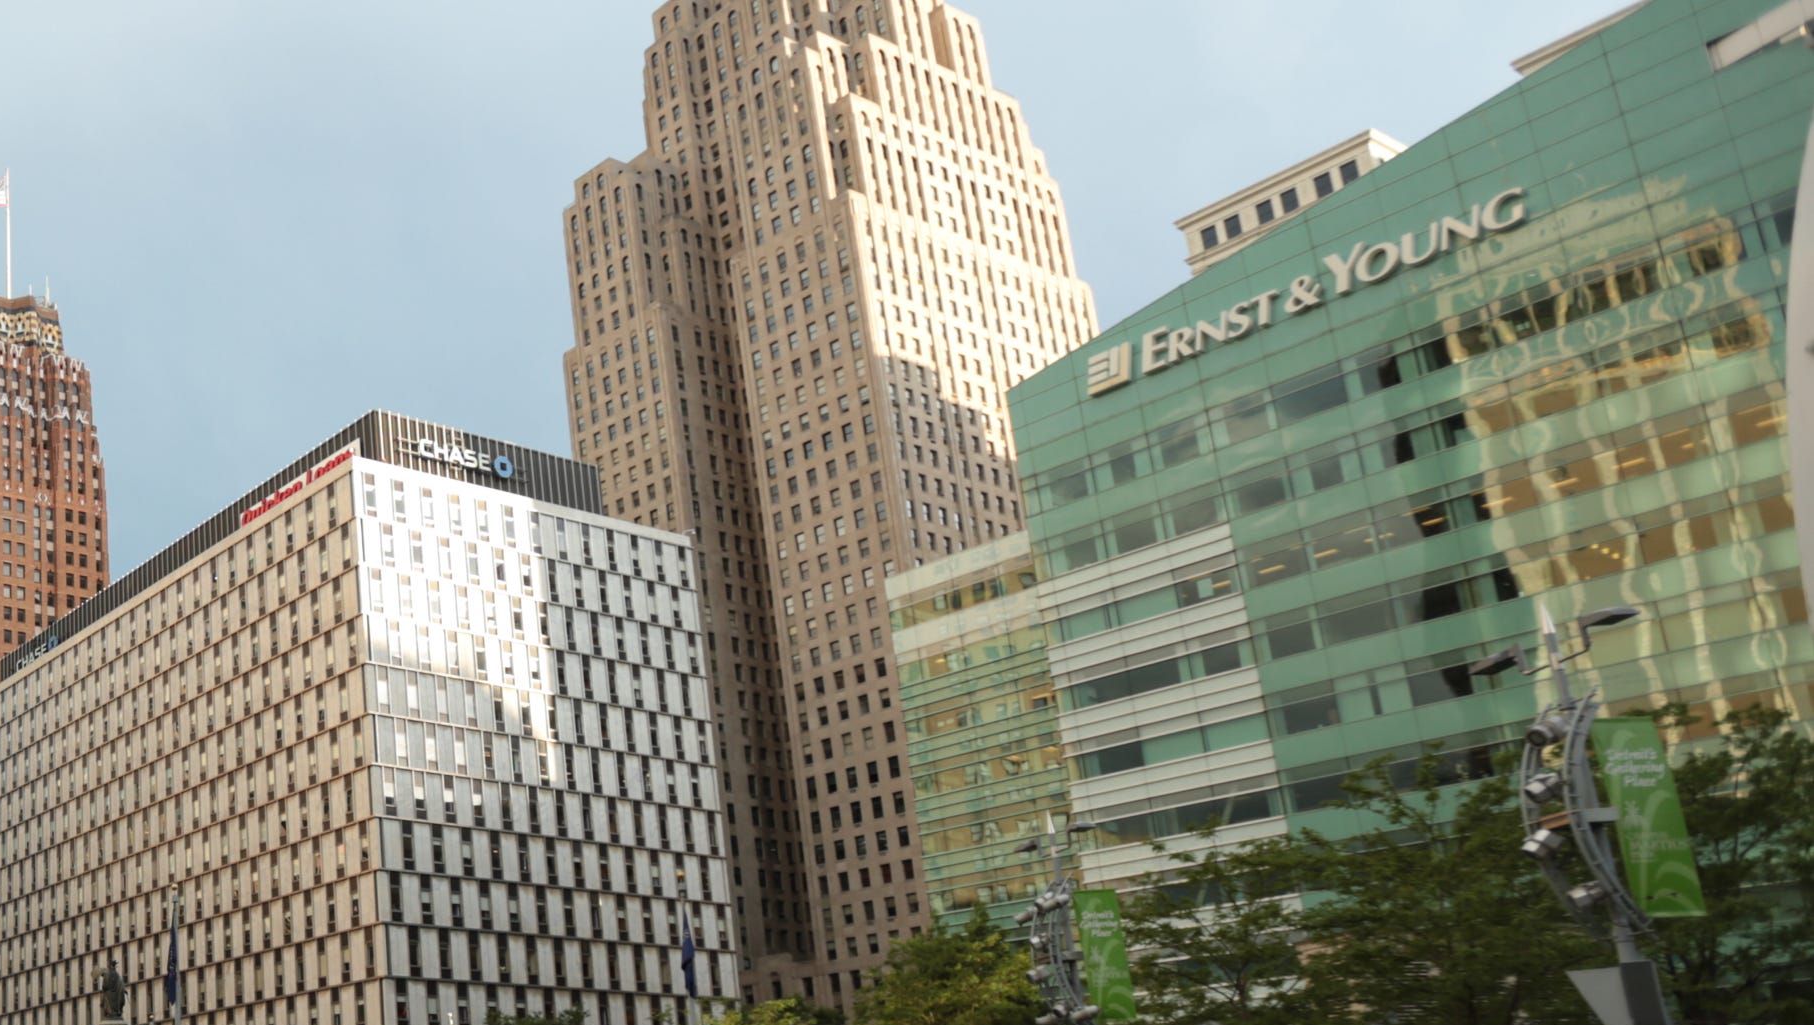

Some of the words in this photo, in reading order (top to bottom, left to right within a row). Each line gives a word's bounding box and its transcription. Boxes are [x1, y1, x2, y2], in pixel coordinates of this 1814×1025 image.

[1142, 290, 1280, 375] ERNST
[1284, 274, 1324, 315] &
[1323, 187, 1526, 295] YOUNG
[241, 480, 303, 528] Quicken
[306, 447, 354, 486] Loans
[419, 437, 492, 472] CHASE
